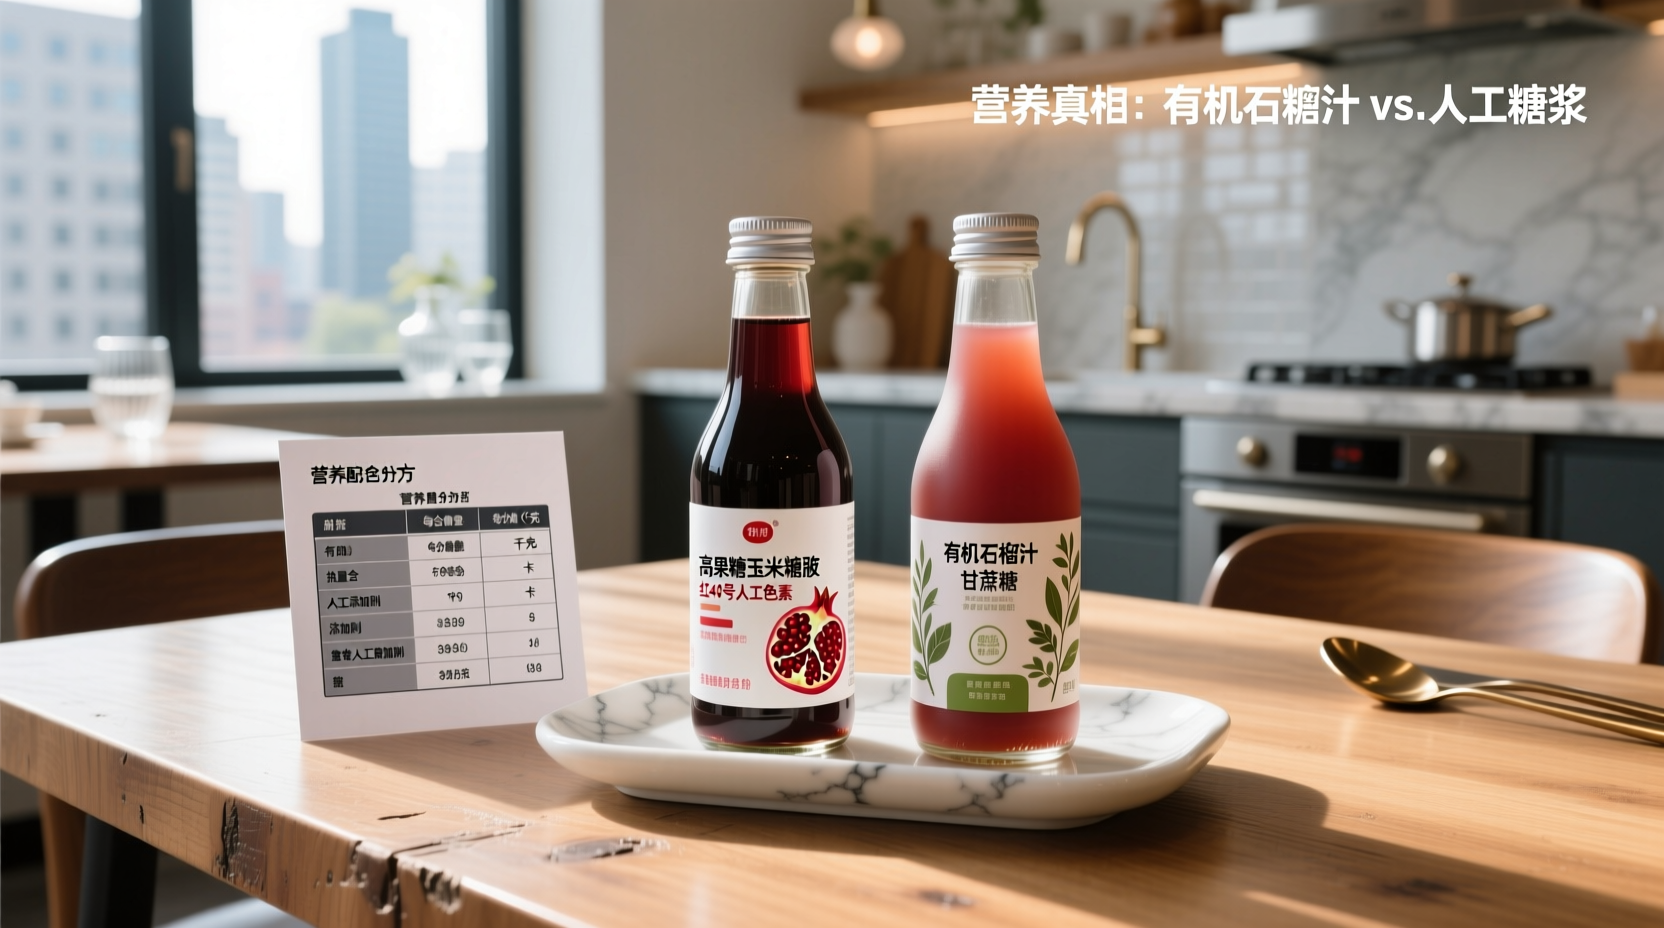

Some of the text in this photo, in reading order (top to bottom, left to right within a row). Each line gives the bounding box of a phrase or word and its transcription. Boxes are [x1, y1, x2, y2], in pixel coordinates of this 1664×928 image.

[944, 540, 1039, 565] 有机石榴汁
[523, 561, 535, 574] 卡
[961, 570, 1018, 592] 甘蔗糖
[525, 585, 536, 599] 卡
